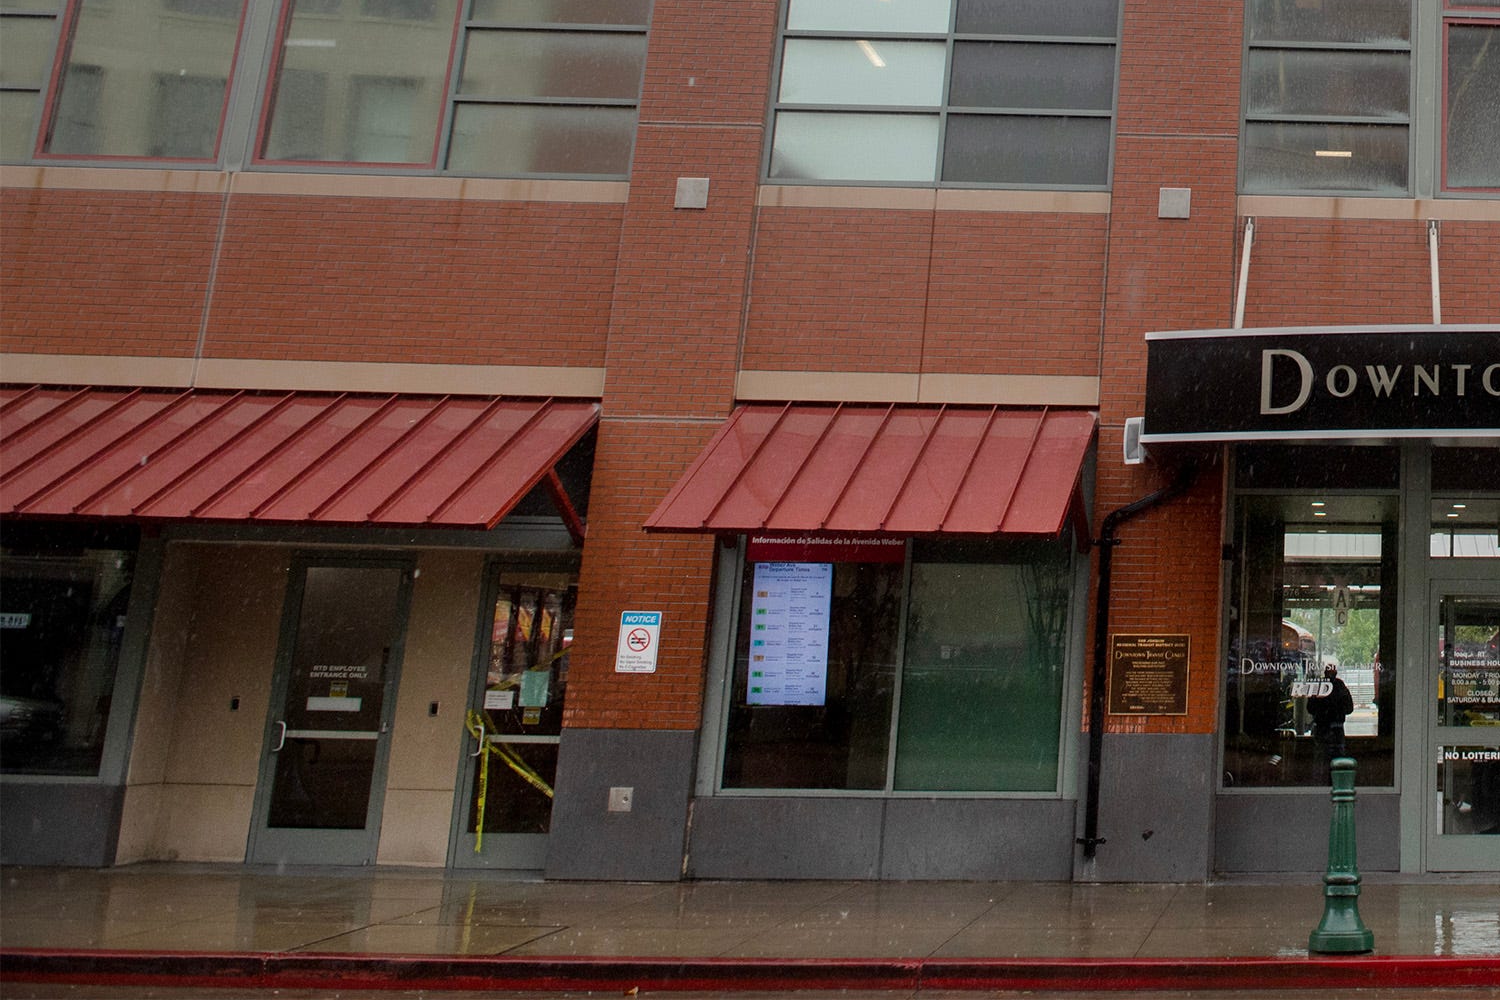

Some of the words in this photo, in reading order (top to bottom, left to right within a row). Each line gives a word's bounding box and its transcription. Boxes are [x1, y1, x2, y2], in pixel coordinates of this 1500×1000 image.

[752, 537, 796, 545] Información
[807, 537, 832, 545] Salidas
[851, 538, 881, 546] Avenida
[881, 538, 905, 546] Weber
[1336, 589, 1347, 608] A
[625, 615, 657, 624] NOTICE
[1338, 611, 1346, 625] C
[1241, 658, 1303, 675] DOWNTOWN
[1291, 682, 1334, 698] RTD
[1445, 752, 1460, 760] NO
